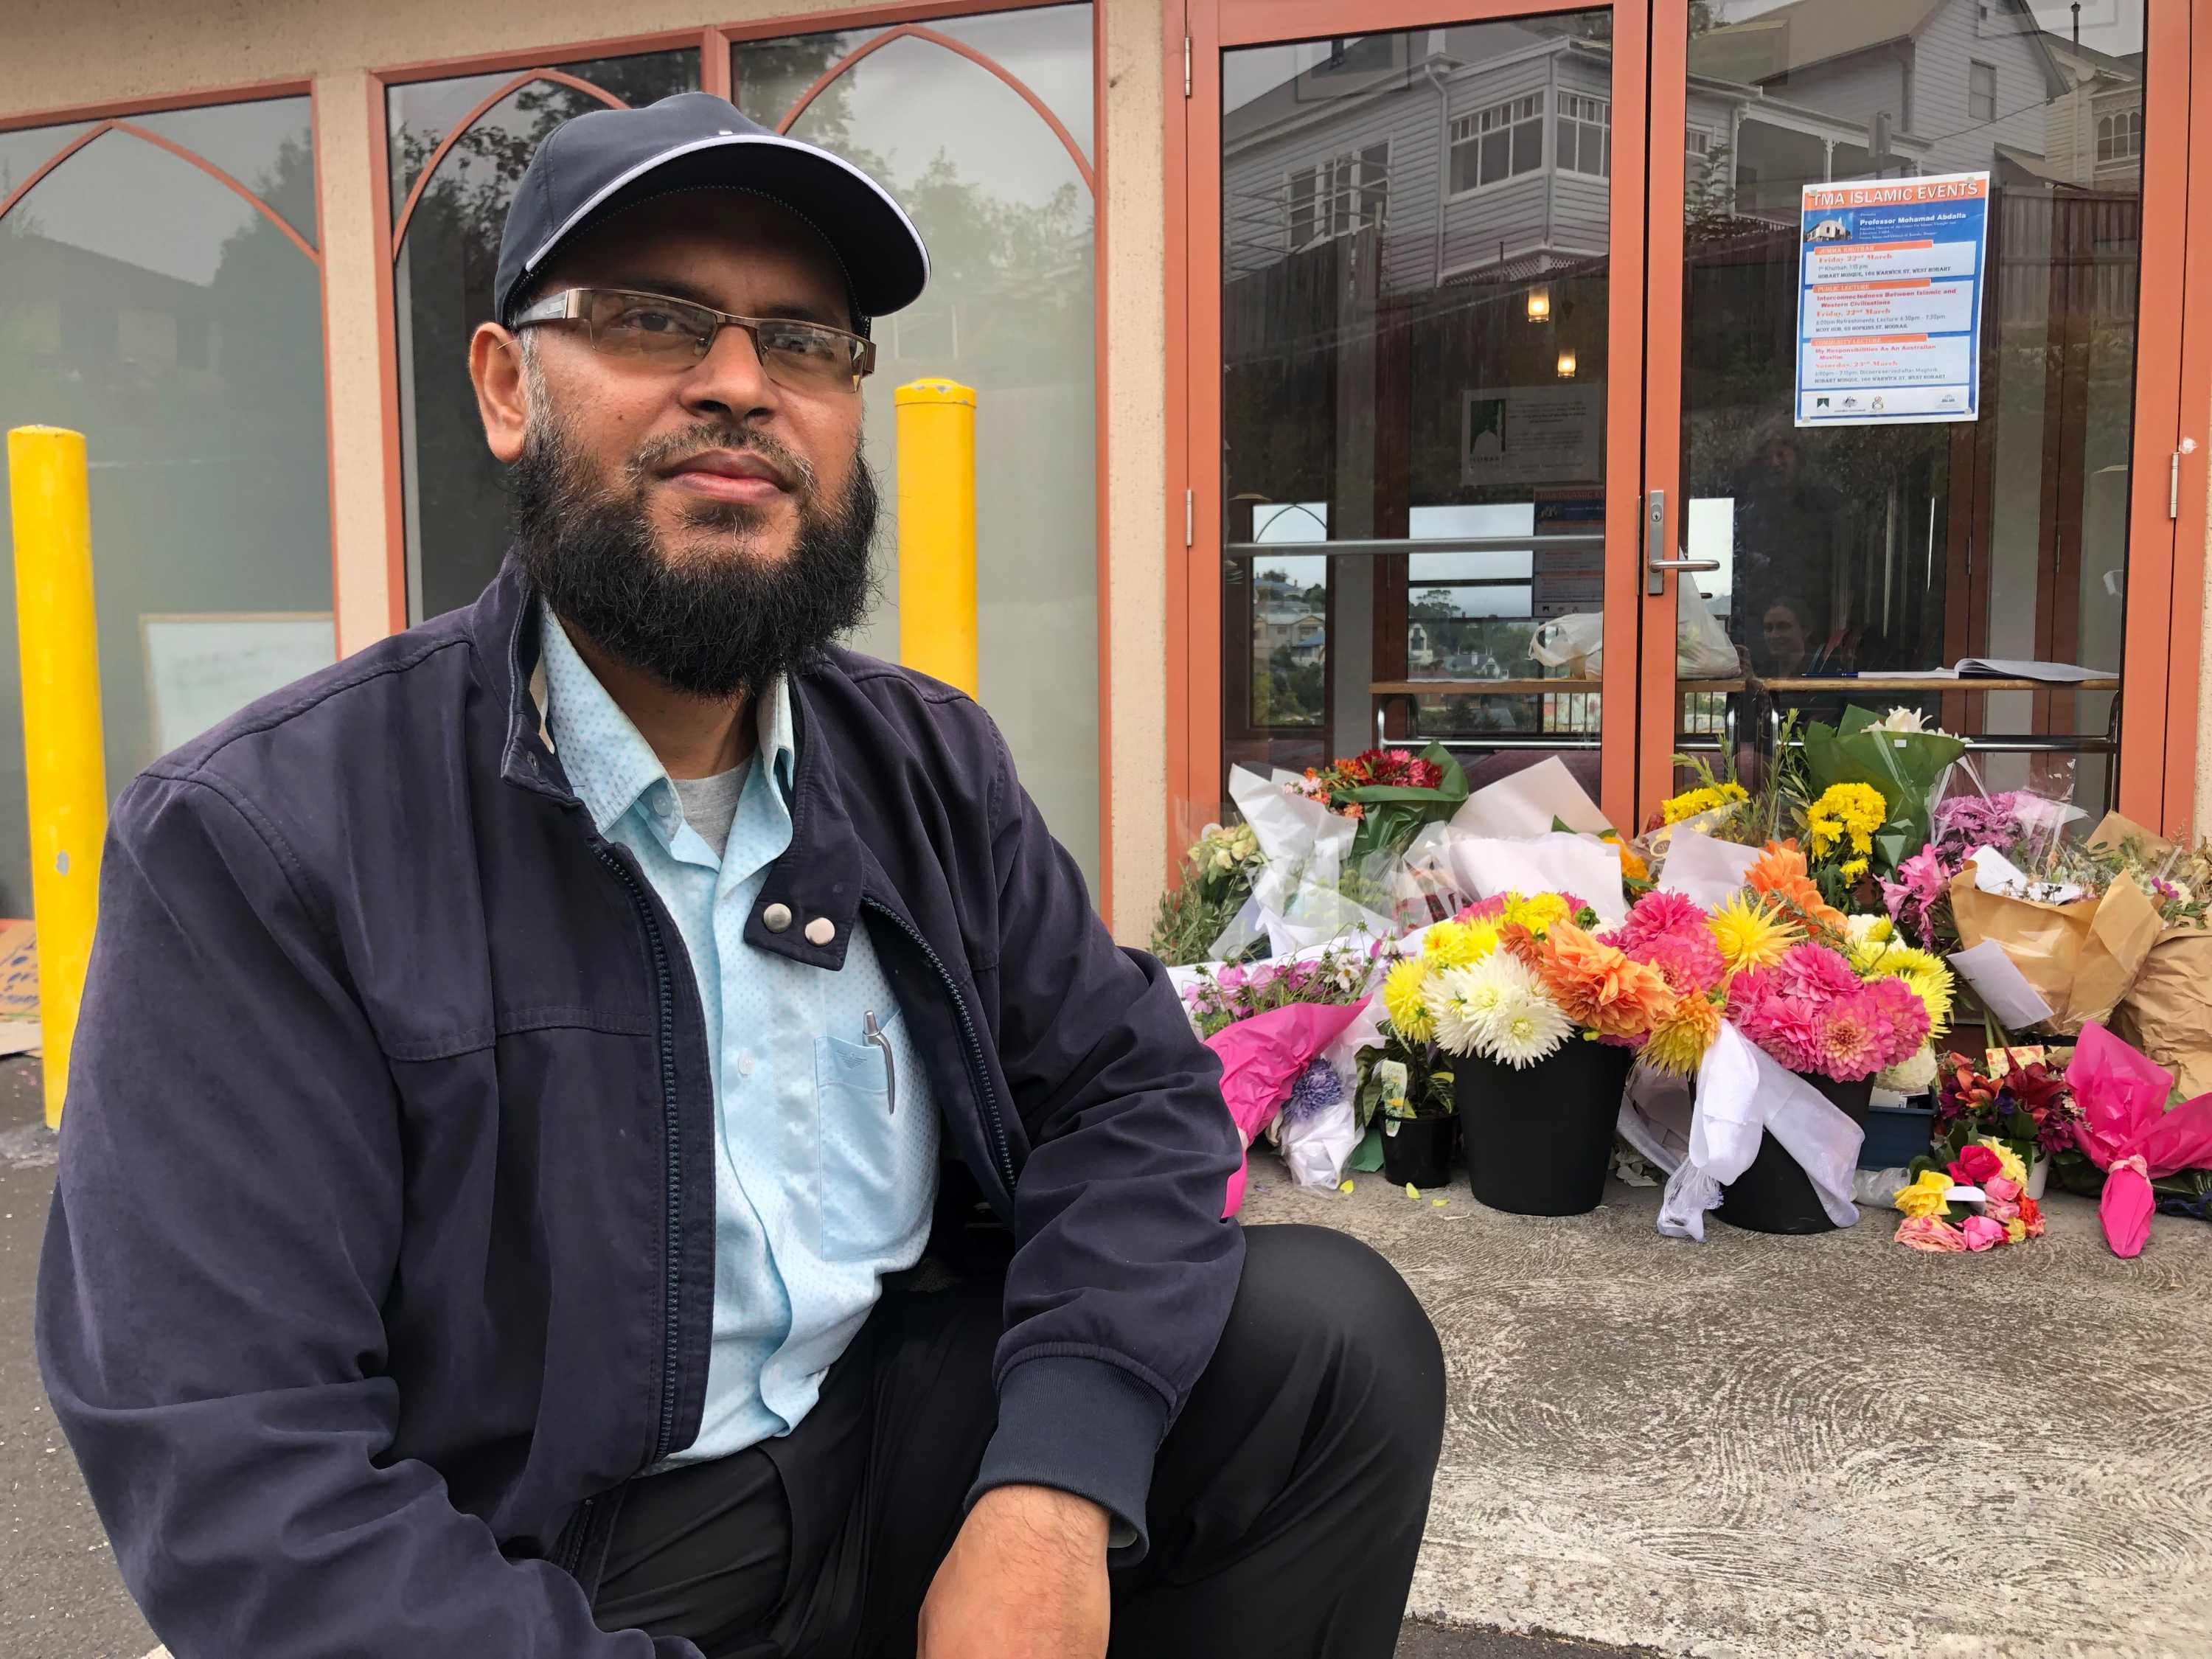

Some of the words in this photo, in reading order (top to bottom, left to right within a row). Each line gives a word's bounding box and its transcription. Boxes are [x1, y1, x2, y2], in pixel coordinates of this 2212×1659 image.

[1815, 193, 1844, 206] TMA
[1850, 188, 1913, 204] ISLAMIC
[1918, 183, 1978, 199] EVENTS
[1860, 218, 1896, 226] Professor
[1898, 215, 1935, 223] Mohamad
[1937, 212, 1966, 220] Abdalla
